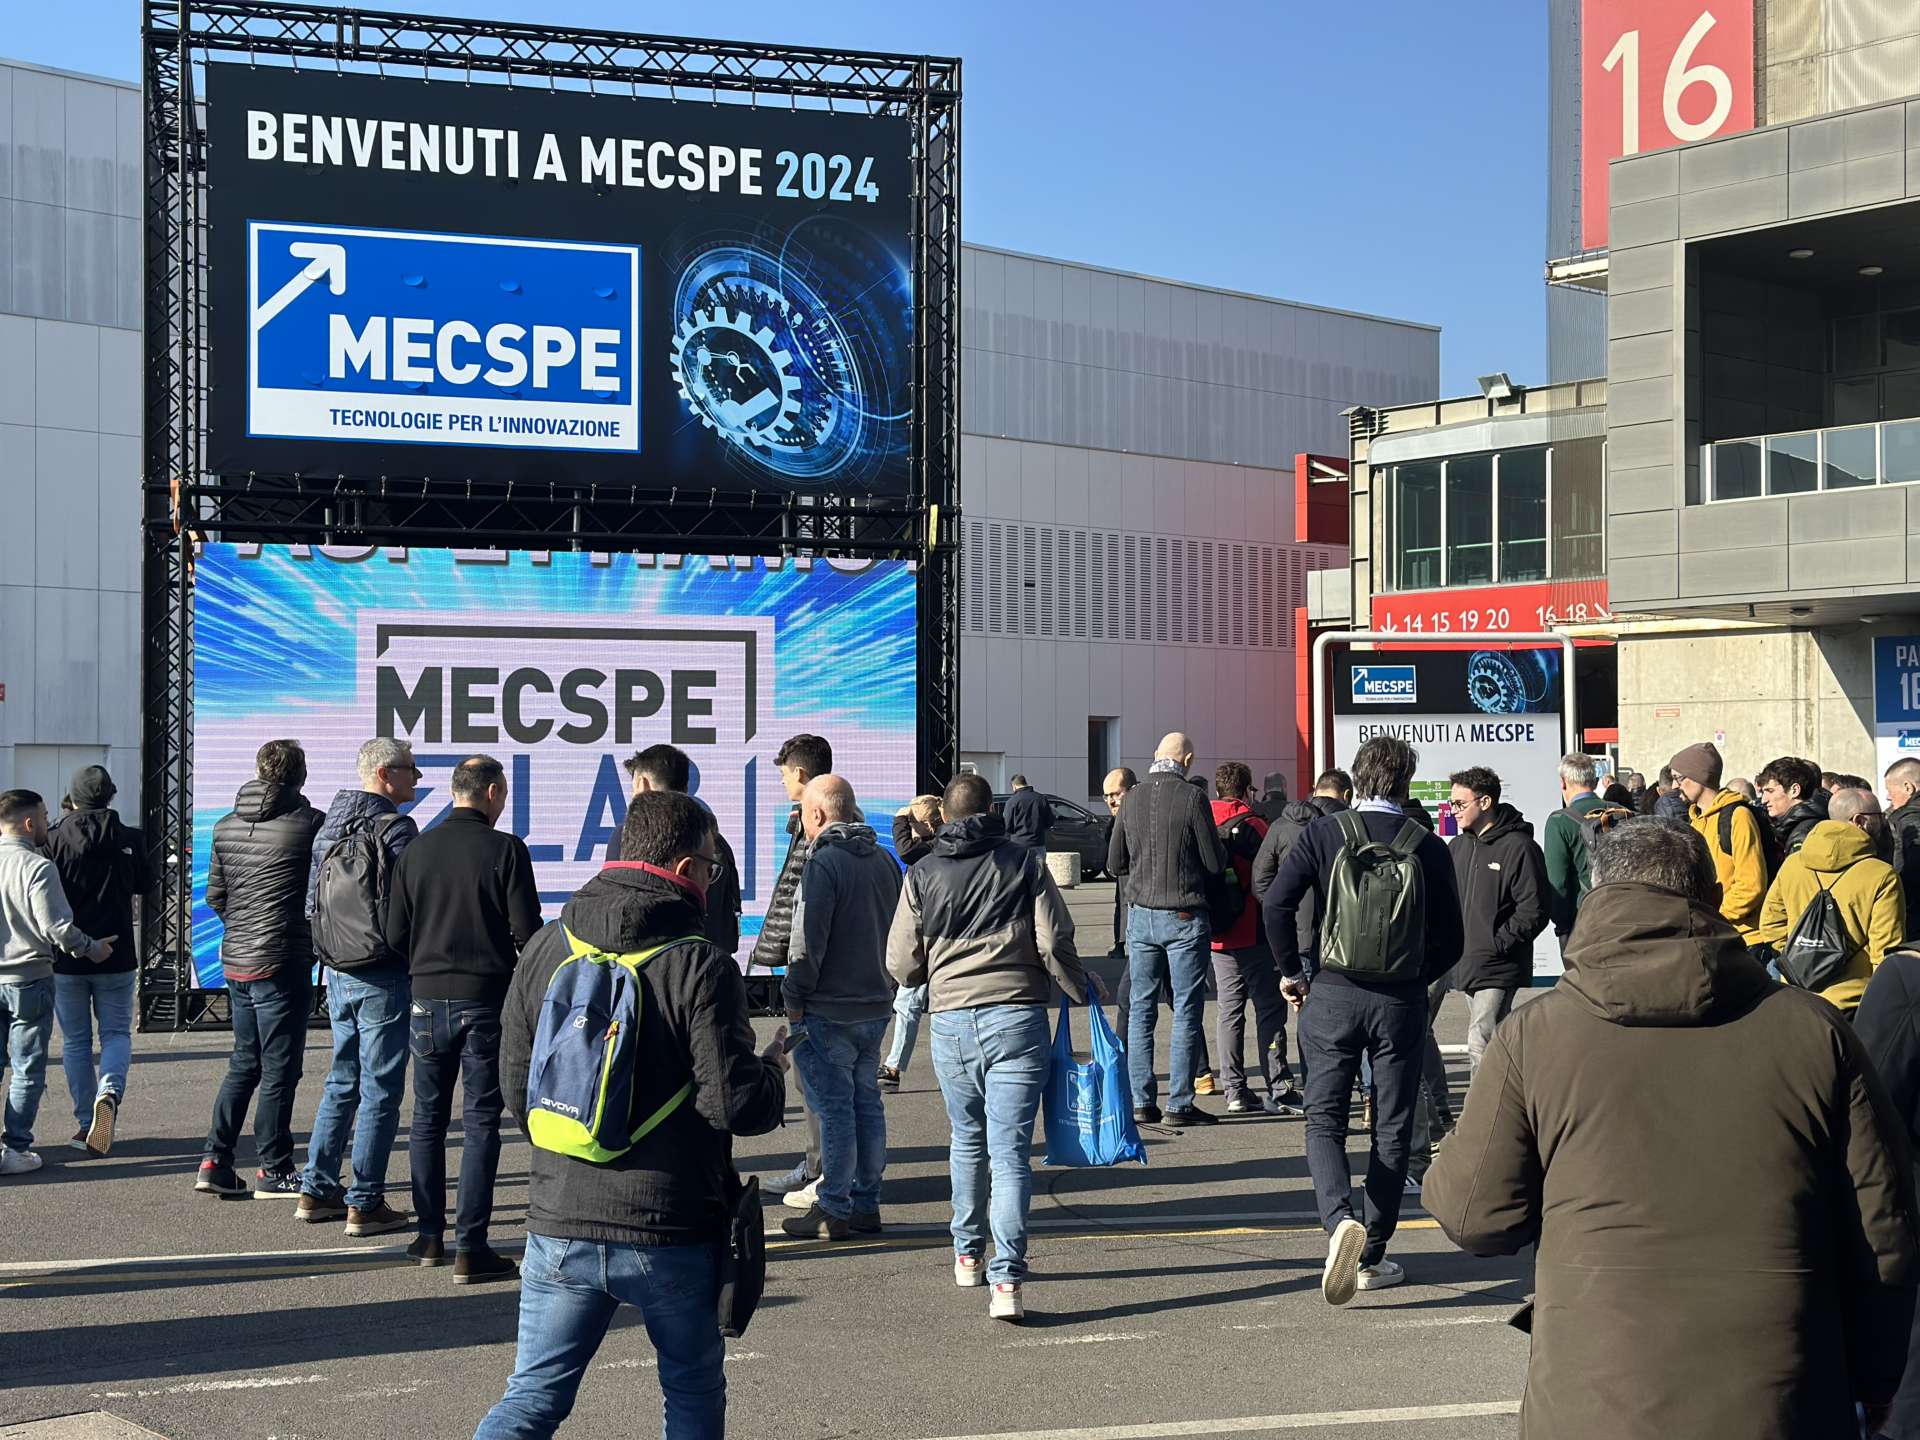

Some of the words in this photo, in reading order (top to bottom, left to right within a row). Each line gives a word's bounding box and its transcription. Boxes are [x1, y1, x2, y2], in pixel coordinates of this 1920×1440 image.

[1601, 10, 1733, 157] 16
[247, 110, 519, 178] BENVENUTI
[532, 132, 567, 181] A
[580, 135, 763, 196] MECSPE
[775, 150, 880, 203] 2024
[329, 313, 621, 392] MECSPE
[329, 408, 443, 430] TECNOLOGIE
[448, 413, 483, 432] PER
[489, 415, 621, 438] L'INNOVAZIONE
[1403, 613, 1424, 633] 14
[1431, 611, 1451, 633] 15
[1458, 610, 1479, 631] 19
[1486, 607, 1510, 629] 20
[1535, 604, 1556, 627] 16
[1566, 602, 1587, 622] 18
[376, 665, 717, 744] MECSPE
[1364, 679, 1414, 693] MECSPE
[1455, 723, 1466, 742] A
[1470, 722, 1535, 742] MECSPE
